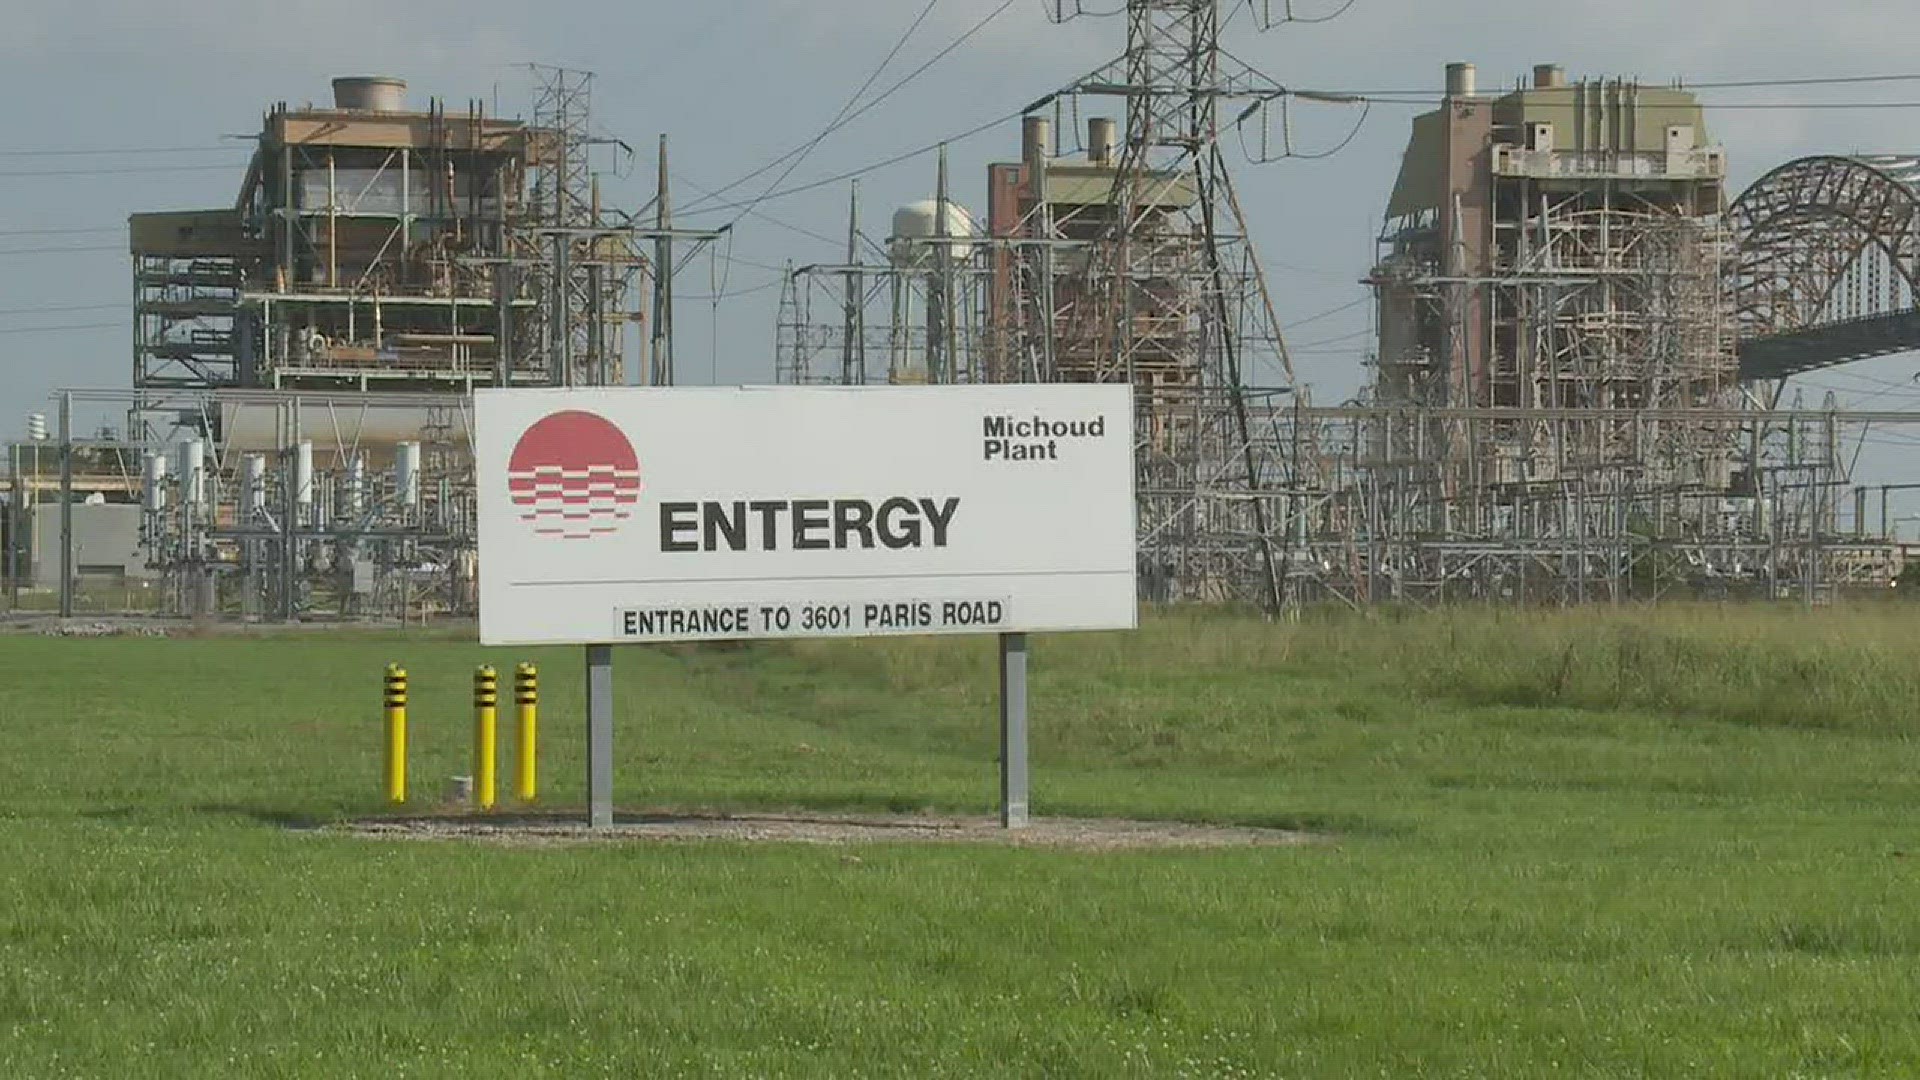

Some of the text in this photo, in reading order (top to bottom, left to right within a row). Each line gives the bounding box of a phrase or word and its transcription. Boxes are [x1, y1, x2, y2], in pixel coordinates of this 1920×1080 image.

[984, 416, 1105, 437] Michoud
[985, 440, 1058, 460] Plant
[660, 497, 960, 552] ENTERGY
[624, 601, 1002, 635] ENTRANCE TO 3601 PARIS ROAD
